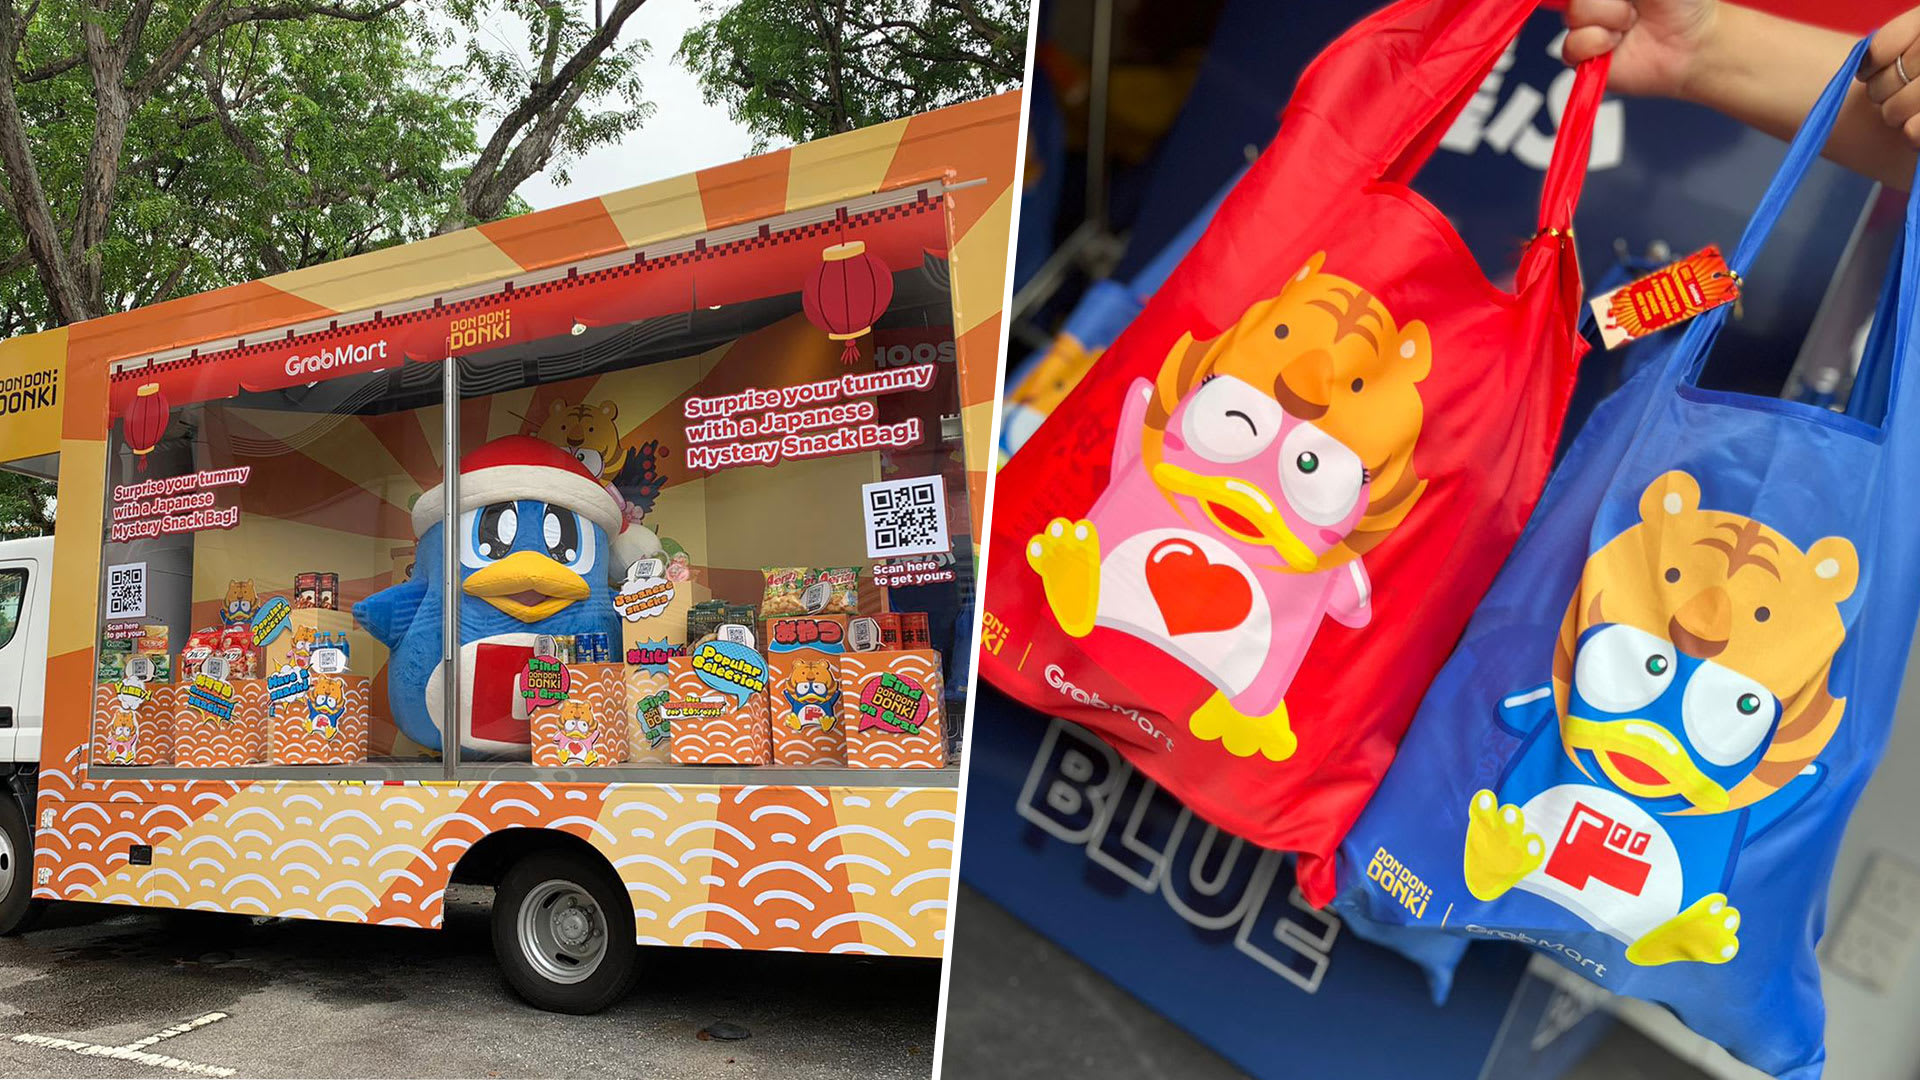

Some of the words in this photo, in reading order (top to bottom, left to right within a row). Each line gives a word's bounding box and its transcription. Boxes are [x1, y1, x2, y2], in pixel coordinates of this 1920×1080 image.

[451, 317, 476, 332] DON
[478, 311, 504, 327] DON
[451, 315, 511, 350] DONKI
[285, 339, 388, 376] GrabMart
[24, 369, 51, 388] DON
[685, 388, 781, 417] Surprise
[784, 380, 841, 406] your
[843, 364, 933, 394] tummy
[686, 419, 739, 442] with
[740, 418, 755, 436] a
[759, 402, 873, 432] Japanese
[688, 440, 780, 469] Mystery
[782, 429, 858, 456] Snack
[859, 418, 919, 447] Bag!
[114, 478, 164, 500] Surprise
[166, 475, 197, 493] your
[199, 466, 250, 486] tummy
[113, 502, 141, 519] with
[141, 502, 151, 514] a
[151, 492, 214, 513] Japanese
[112, 520, 160, 539] Mystery
[161, 512, 204, 531] Snack
[204, 505, 238, 524] Bag!
[873, 565, 904, 574] Scan
[906, 562, 936, 572] here
[873, 576, 888, 586] to
[890, 574, 913, 586] get
[915, 571, 952, 583] yours
[614, 580, 674, 607] Japanese
[625, 595, 668, 616] snacks
[107, 623, 123, 631] Scan
[124, 622, 138, 630] here
[115, 631, 127, 639] get
[127, 630, 146, 639] yours
[692, 655, 764, 693] Selection
[702, 645, 762, 678] Popular
[528, 677, 561, 689] DONKI
[881, 672, 923, 700] Find
[860, 703, 877, 716] on
[881, 710, 920, 735] Grab
[871, 693, 918, 719] DONKI
[1044, 664, 1175, 752] GrabMart
[1016, 717, 1341, 994] BLUE
[1375, 846, 1403, 878] DON
[1400, 867, 1429, 897] DON
[1366, 857, 1433, 919] DONKI
